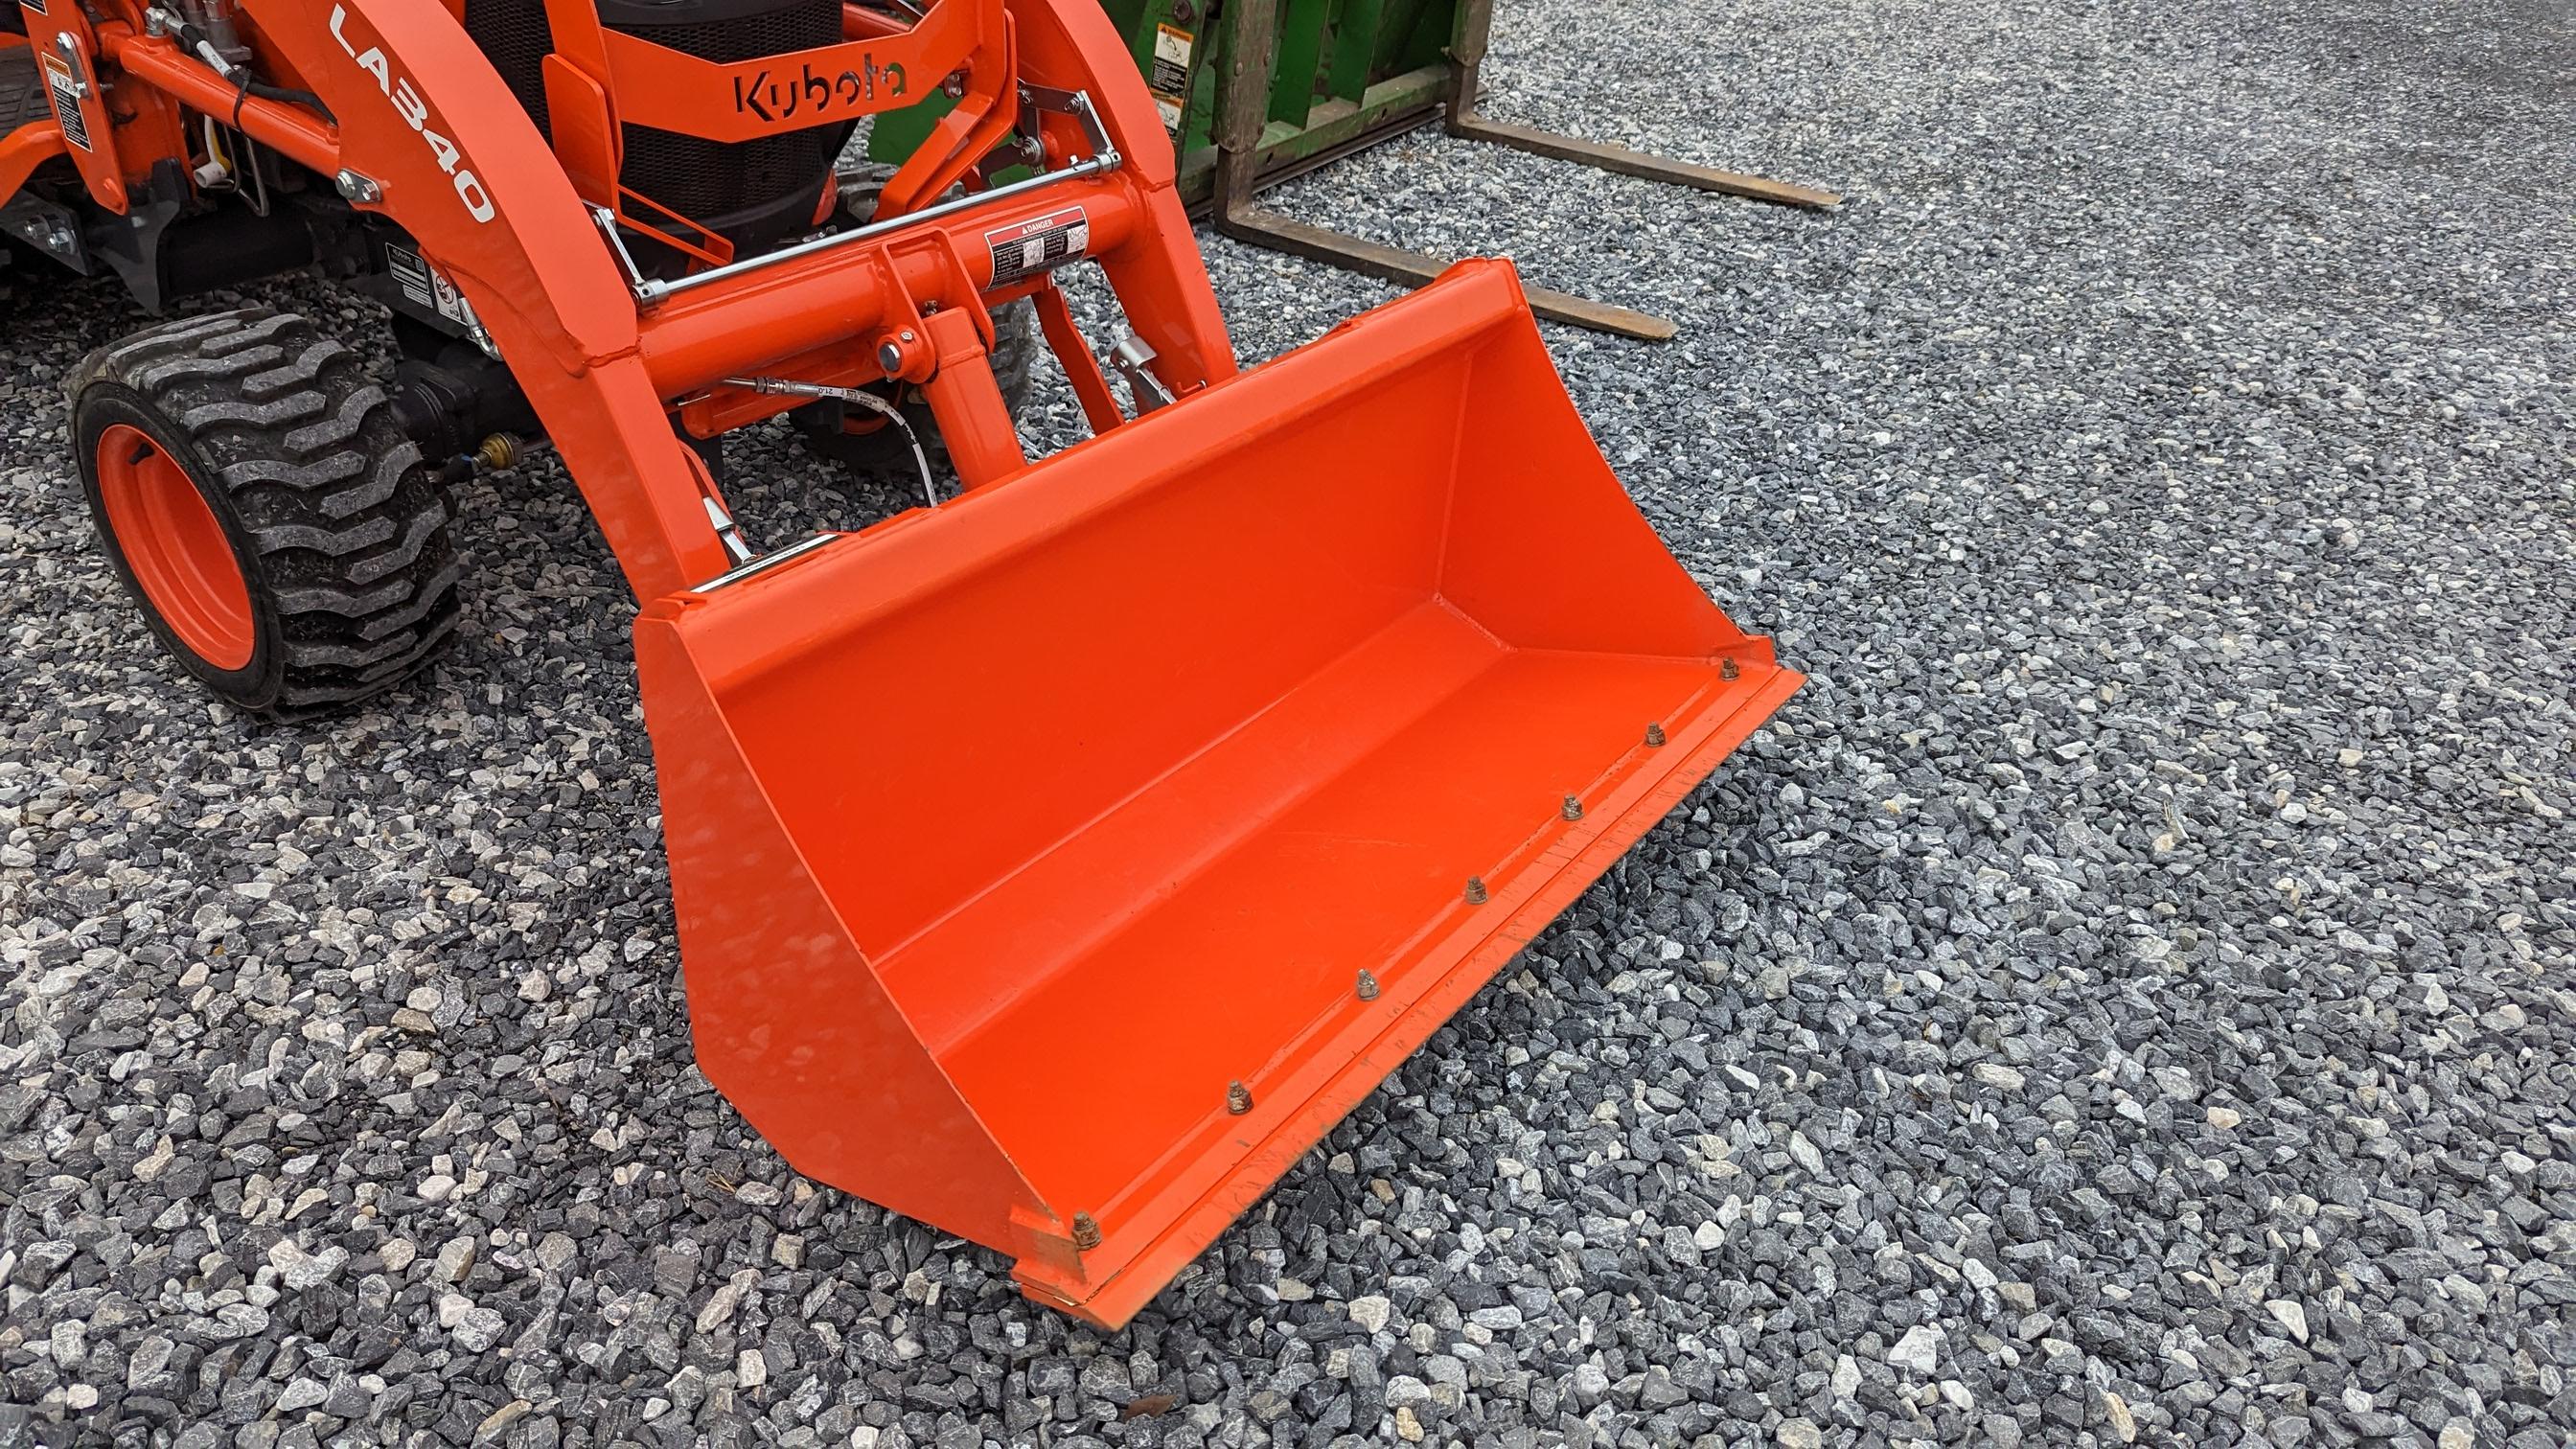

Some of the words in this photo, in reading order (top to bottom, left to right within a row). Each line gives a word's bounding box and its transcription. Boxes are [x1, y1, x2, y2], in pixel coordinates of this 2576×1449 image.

[330, 3, 494, 222] LA340
[734, 53, 907, 122] Kubota
[1027, 219, 1054, 232] DANGER
